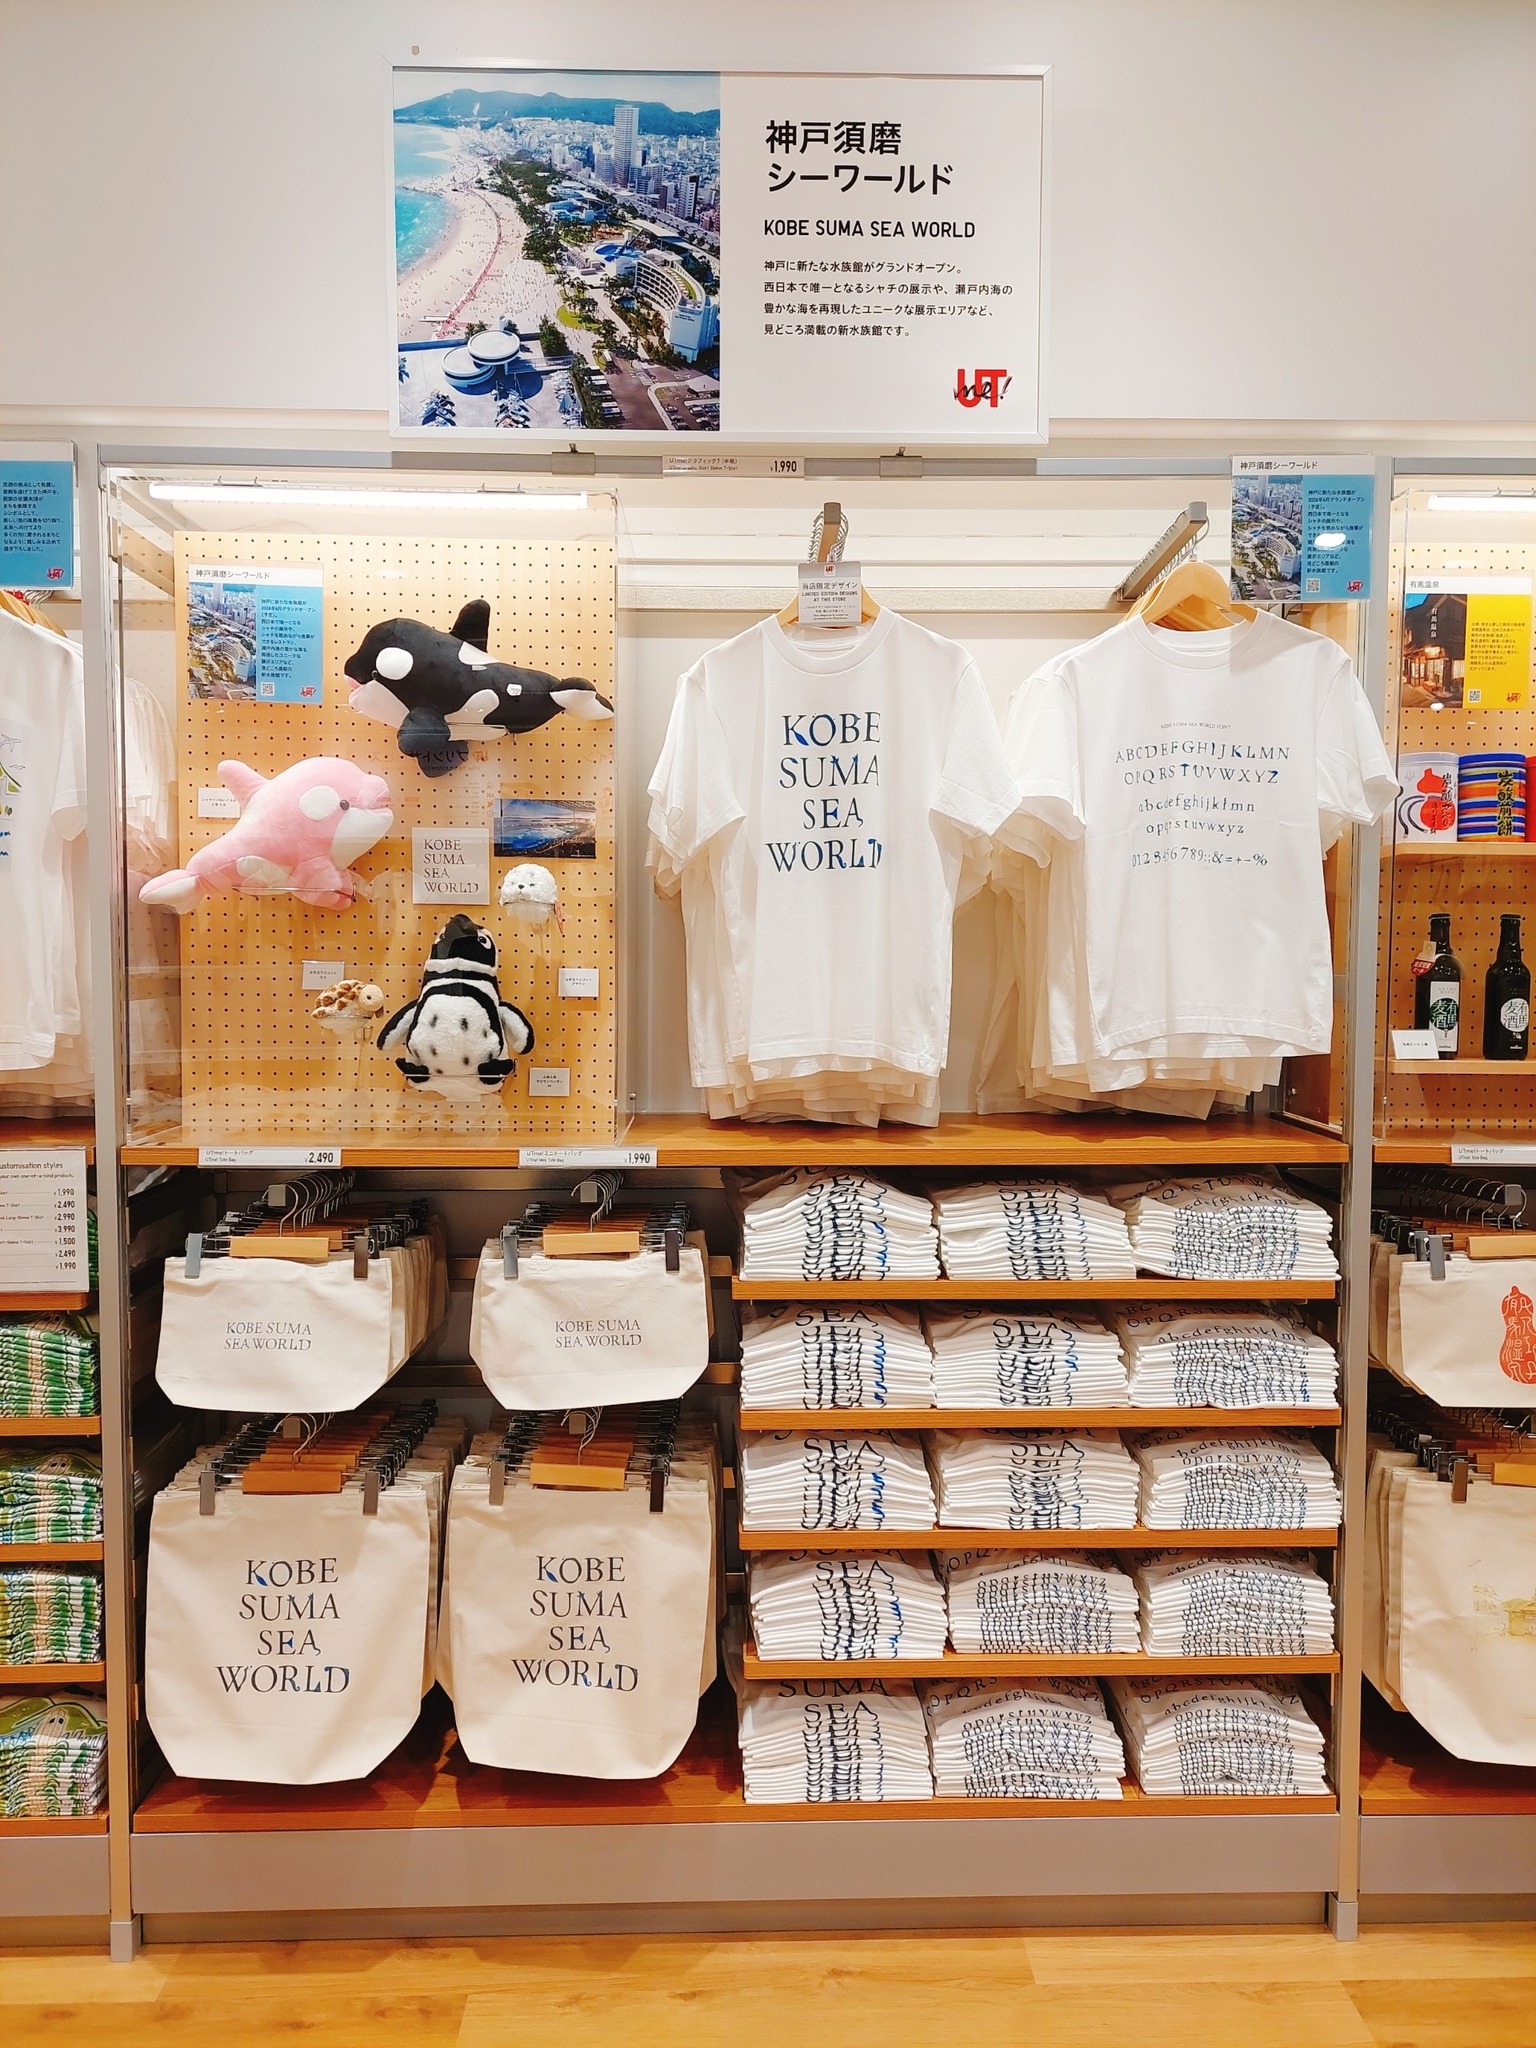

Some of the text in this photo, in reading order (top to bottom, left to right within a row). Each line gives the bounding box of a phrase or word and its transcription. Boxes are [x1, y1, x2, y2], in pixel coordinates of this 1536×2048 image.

[764, 120, 902, 156] 神戸須磨
[768, 162, 954, 196] シーワールド
[764, 220, 976, 238] KOBE SUMA SEA WORLD
[764, 260, 962, 274] 神戸に新たな水族館がグランドオープン。
[764, 282, 1014, 296] 西日本で唯一となるシャチの展示や、瀬戸内海の
[764, 302, 994, 318] 豊かな海を再現したユニークな展示エリアなど、
[764, 324, 910, 336] 見どころ満載の新水族館です。
[1240, 462, 1318, 470] 神戸須磨シーワールド
[196, 568, 270, 580] 神戸須磨シーワールド
[1410, 580, 1440, 588] 有馬温泉
[782, 712, 881, 746] KOBE
[779, 752, 880, 789] SUMA
[1496, 770, 1514, 836] 炭酸煎餅
[802, 796, 864, 830] SEA
[424, 838, 462, 851] KOBE
[423, 852, 465, 866] SUMA
[424, 867, 450, 879] SEA
[424, 882, 479, 894] WORLD
[304, 1152, 334, 1164] ¥2,490
[624, 1152, 650, 1164] ¥1,990
[0, 1162, 63, 1172] ustomisation styles
[53, 1188, 75, 1197] ¥1,990
[54, 1200, 76, 1209] ¥2,490
[54, 1213, 76, 1221] ¥2,990
[54, 1226, 76, 1234] ¥3,990
[54, 1238, 76, 1246] ¥1,500
[55, 1250, 76, 1258] ¥2,490
[55, 1262, 77, 1270] ¥1,990
[794, 1308, 878, 1328] SEA
[226, 1322, 312, 1336] KOBE SUMA
[554, 1319, 641, 1332] KOBE SUMA
[224, 1338, 312, 1351] SEA WORLD
[555, 1334, 642, 1348] SEA WORLD
[244, 1558, 339, 1588] KOBE
[536, 1555, 626, 1584] KOBE
[816, 1560, 895, 1584] SEA
[238, 1592, 341, 1622] SUMA
[529, 1589, 628, 1620] SUMA
[257, 1629, 322, 1656] SEA
[548, 1626, 611, 1654] SEA
[214, 1664, 350, 1694] WORLD
[510, 1658, 639, 1692] WORLD
[804, 1700, 878, 1722] SEA
